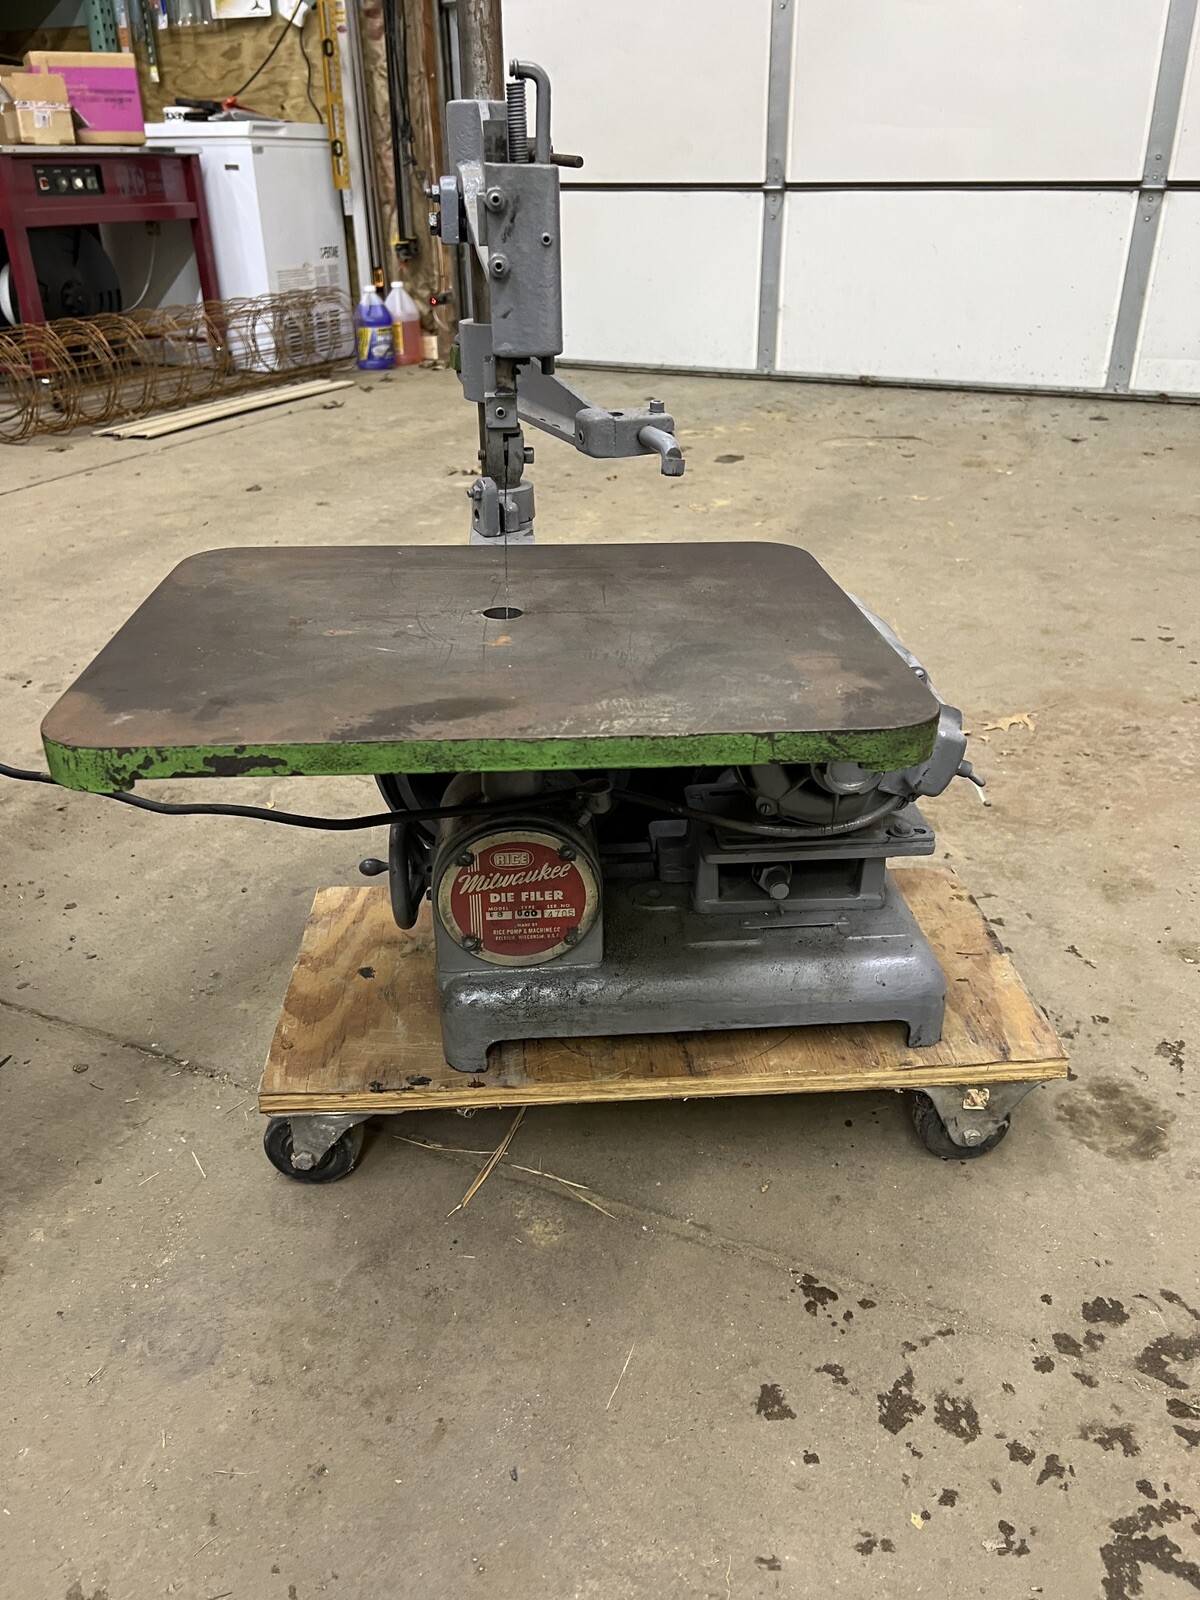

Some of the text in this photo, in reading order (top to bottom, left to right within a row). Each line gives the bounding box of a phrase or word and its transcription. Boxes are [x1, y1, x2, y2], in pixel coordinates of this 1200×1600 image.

[494, 852, 529, 866] RICE
[458, 862, 571, 894] Milwaukee
[490, 890, 563, 903] DIE FILER
[547, 909, 574, 917] 4705
